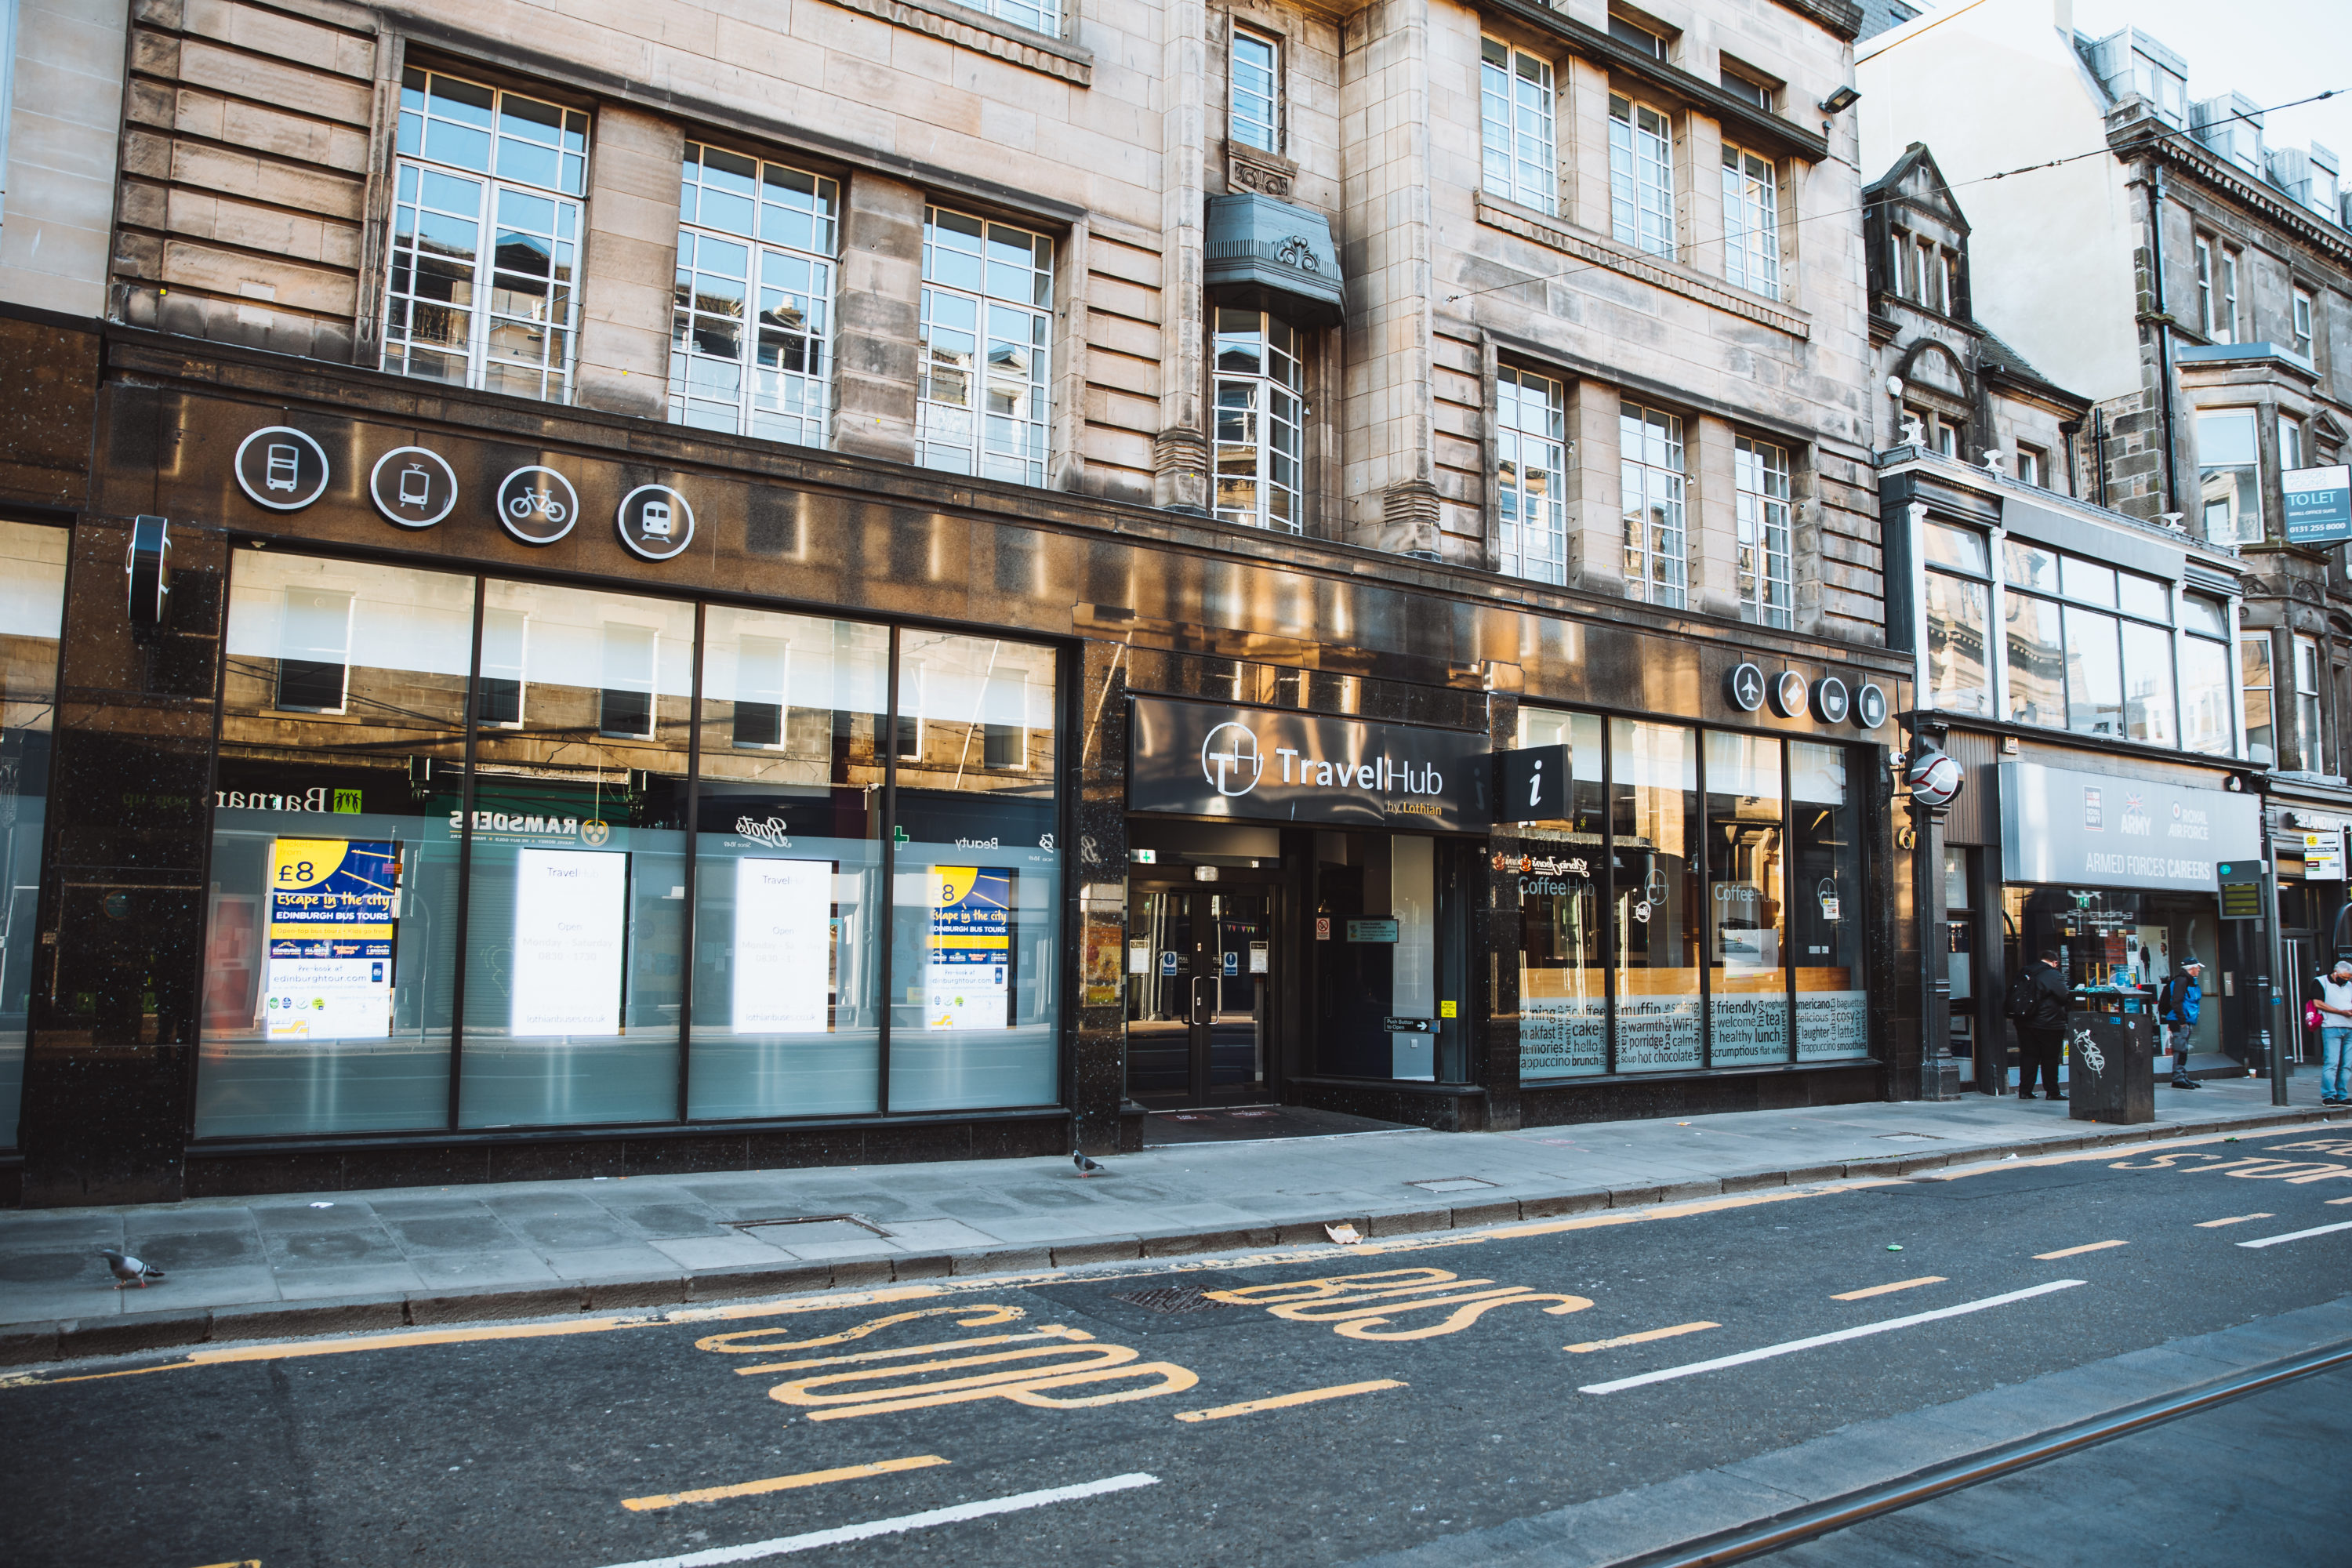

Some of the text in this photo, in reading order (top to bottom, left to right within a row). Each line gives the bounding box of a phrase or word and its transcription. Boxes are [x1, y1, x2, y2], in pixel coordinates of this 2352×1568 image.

[2287, 491, 2336, 506] TO LET
[2326, 522, 2346, 531] 8000
[1276, 747, 1443, 795] TravelHub
[1530, 760, 1542, 807] i
[1387, 800, 1442, 816] by Lothian
[2182, 809, 2208, 824] ROYAL
[2121, 814, 2151, 836] ARMY
[1898, 826, 1916, 849] 61
[2085, 852, 2210, 880] ARMED FORCES CAREERS
[277, 891, 390, 911] Escape in the city
[276, 911, 333, 920] EDINBURGH
[961, 910, 971, 923] in
[973, 909, 988, 920] the
[991, 909, 1007, 925] city
[557, 922, 583, 931] Open
[773, 927, 794, 935] Open
[523, 938, 614, 948] Monday Saturday
[274, 975, 367, 983] edinburghtour.com
[1621, 1002, 1661, 1015] muffin
[1717, 1000, 1757, 1015] friendly
[1765, 999, 1788, 1010] yoghurt
[1795, 998, 1830, 1010] americano
[1837, 998, 1865, 1010] baguettes
[1718, 1016, 1756, 1028] welcome
[1766, 1011, 1780, 1026] tea
[1796, 1012, 1828, 1022] delicious
[1837, 1011, 1855, 1025] cosy
[1573, 1020, 1599, 1036] cake
[1628, 1019, 1664, 1033] warmth
[1672, 1018, 1693, 1032] WiFi
[1838, 1024, 1854, 1038] latte
[1672, 1033, 1693, 1047] calm
[1719, 1029, 1752, 1044] healthy
[1755, 1027, 1780, 1043] lunch
[1802, 1025, 1829, 1041] laughter
[1574, 1040, 1598, 1052] hello
[1629, 1033, 1663, 1050] porridge
[1802, 1040, 1835, 1054] frappuccino
[1837, 1040, 1867, 1051] smoothies
[1638, 1048, 1693, 1064] hot chocolate
[1710, 1045, 1758, 1058] scrumptious
[1760, 1045, 1788, 1054] flat white
[1572, 1054, 1598, 1066] brunch
[1621, 1055, 1636, 1064] soup
[1200, 1267, 1595, 1342] BUS
[695, 1303, 1200, 1423] STOP
